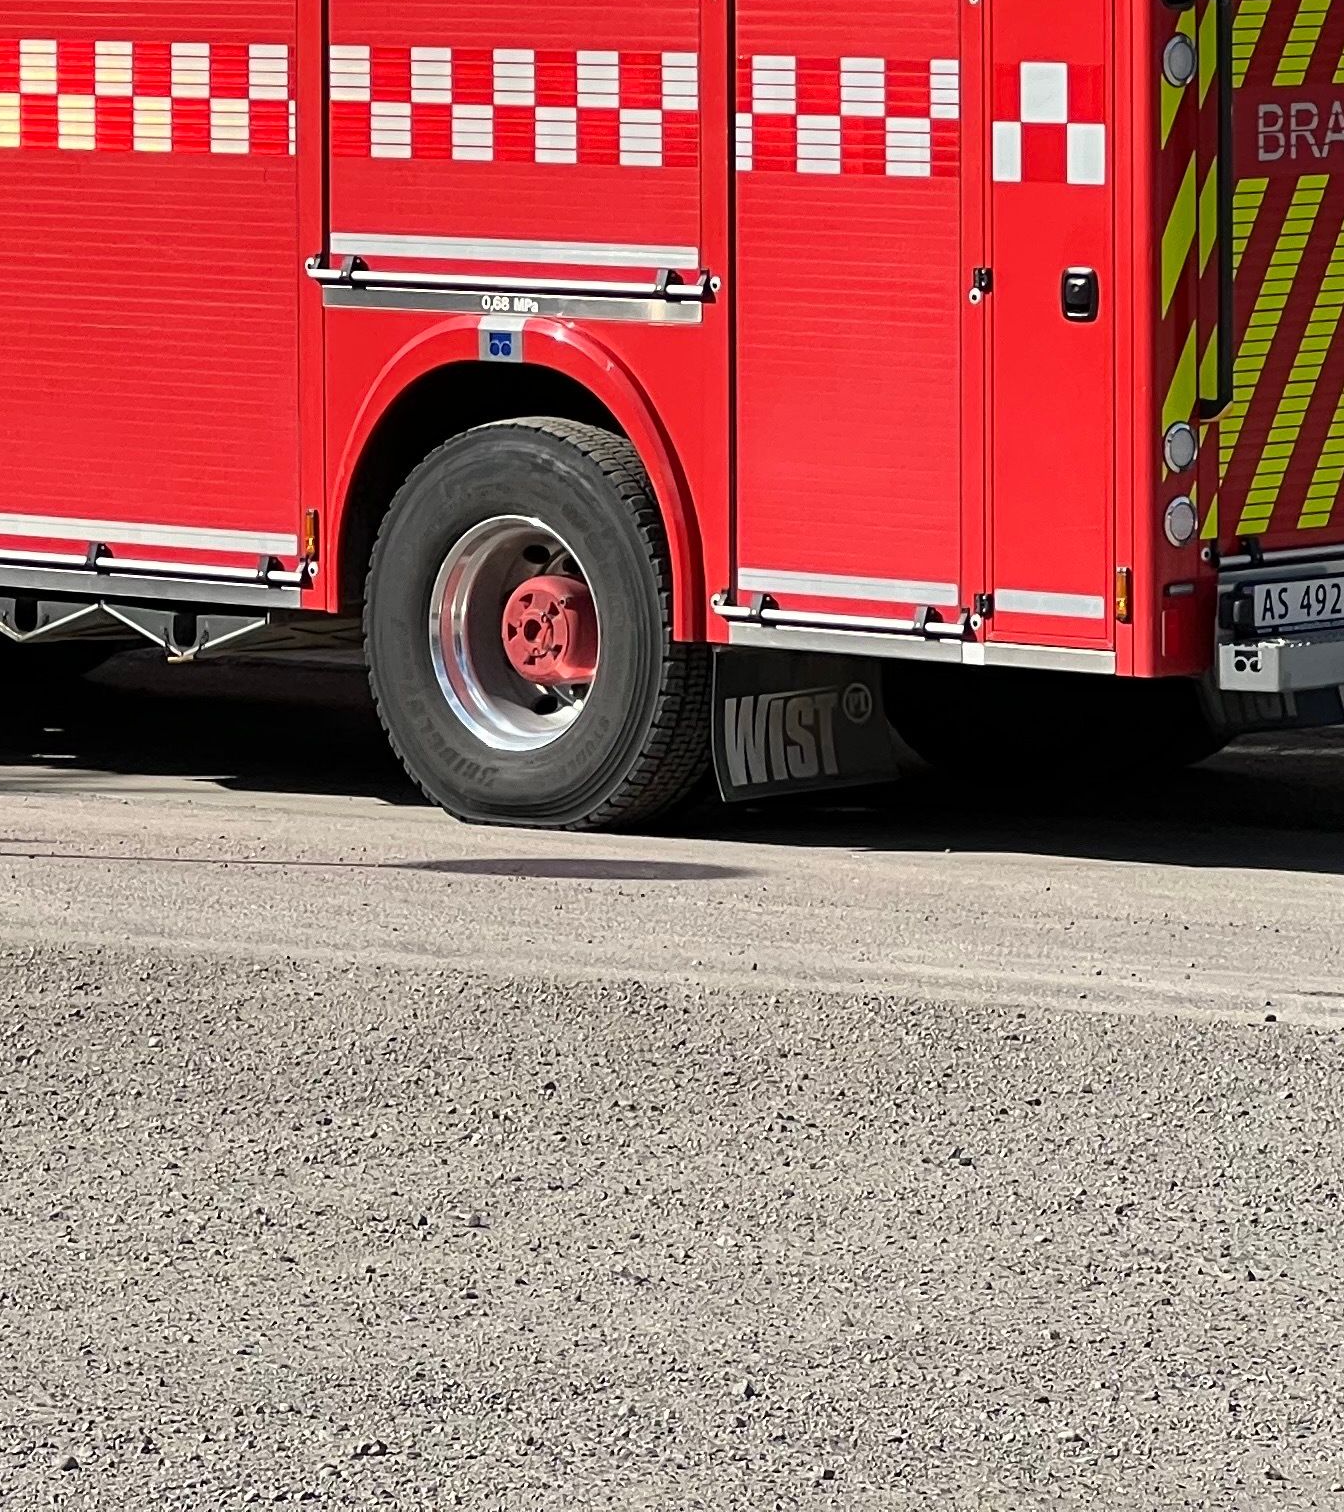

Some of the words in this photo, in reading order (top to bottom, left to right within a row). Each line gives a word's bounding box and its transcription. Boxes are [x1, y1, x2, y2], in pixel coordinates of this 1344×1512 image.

[481, 295, 510, 312] 0,68
[513, 297, 539, 313] MPa
[1262, 588, 1289, 621] AS
[724, 685, 842, 788] WIST
